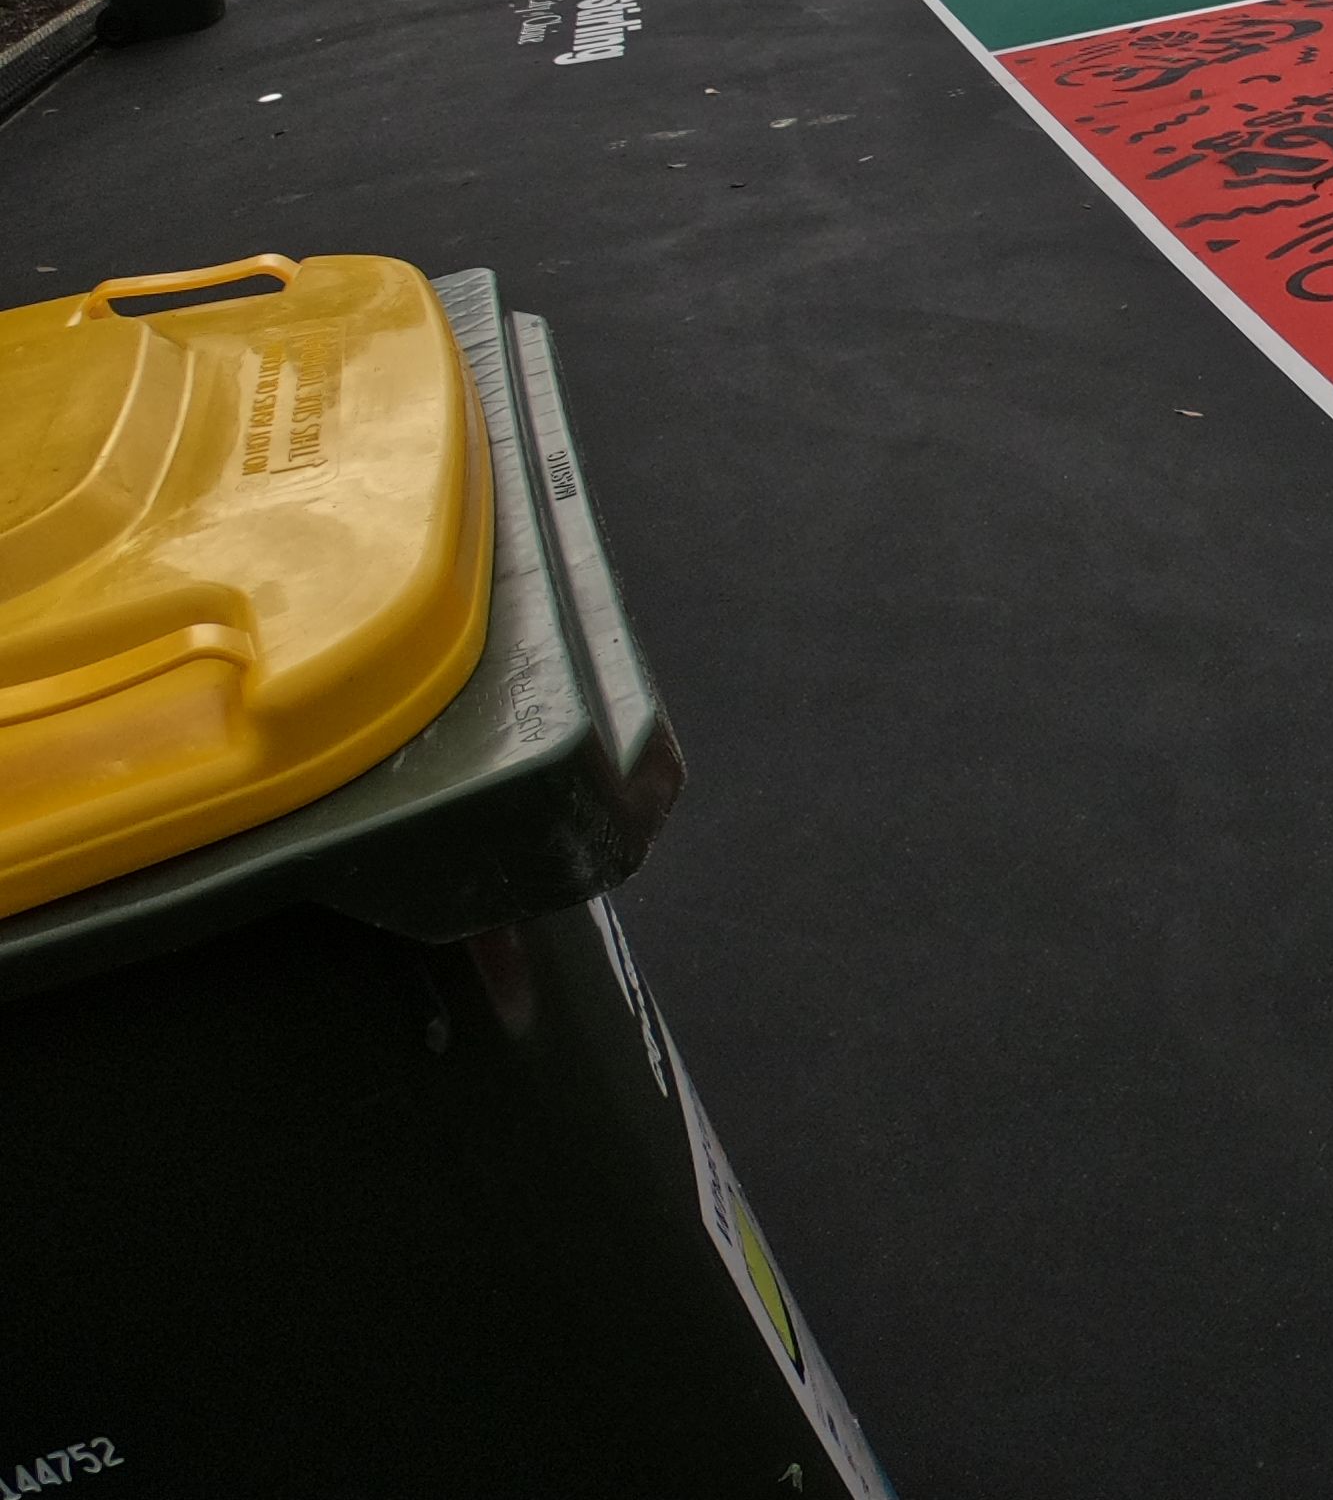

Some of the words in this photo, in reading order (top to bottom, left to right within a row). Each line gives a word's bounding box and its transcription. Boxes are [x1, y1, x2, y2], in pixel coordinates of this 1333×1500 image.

[292, 394, 323, 423] SIDE
[289, 423, 321, 462] THIS
[504, 637, 545, 744] AUSTRALIA
